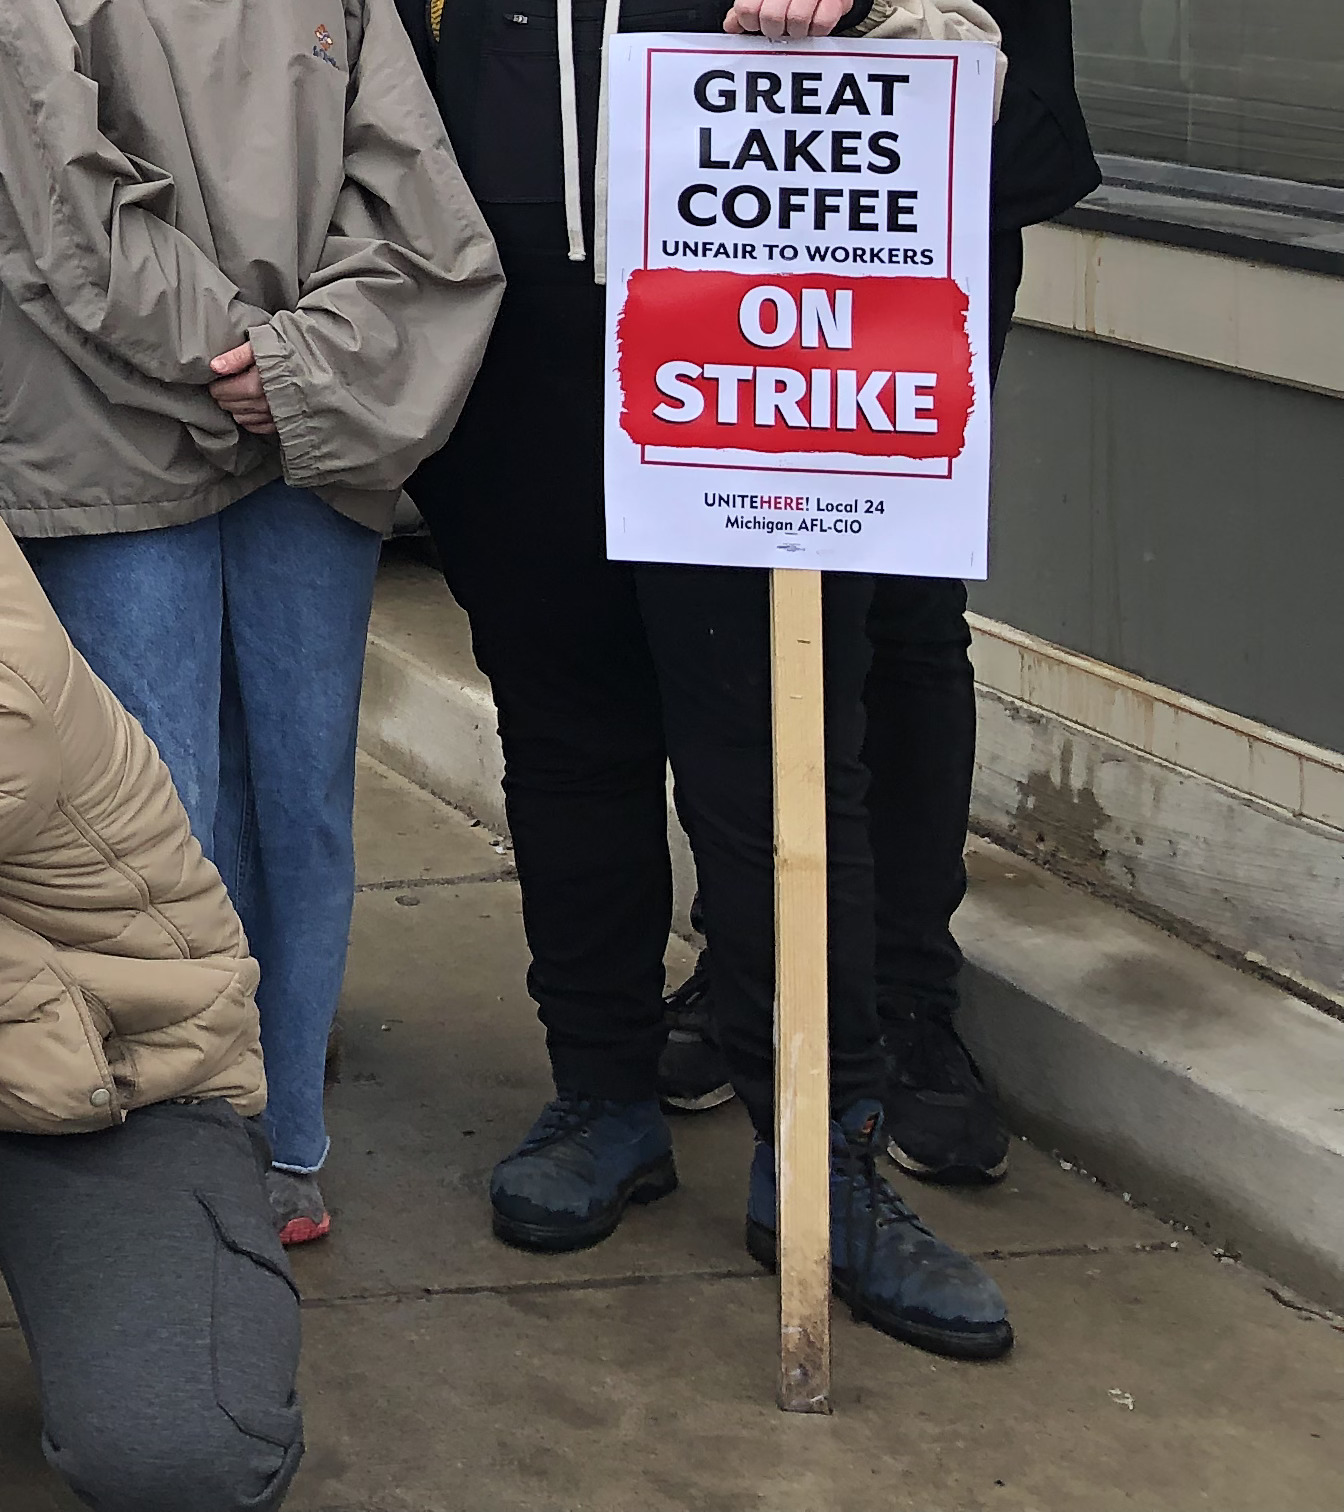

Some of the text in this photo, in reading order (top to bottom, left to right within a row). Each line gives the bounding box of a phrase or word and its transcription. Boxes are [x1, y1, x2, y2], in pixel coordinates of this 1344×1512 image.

[694, 70, 909, 116] GREAT
[699, 127, 900, 174] LAKES
[678, 184, 918, 232] COFFEE
[662, 240, 933, 265] UNFAIR TO WORKERS
[740, 286, 852, 348] ON
[653, 361, 937, 432] STRIKE
[705, 493, 884, 514] UNITEHERE! Local 24
[726, 515, 861, 534] Michigan AFL-CIO
